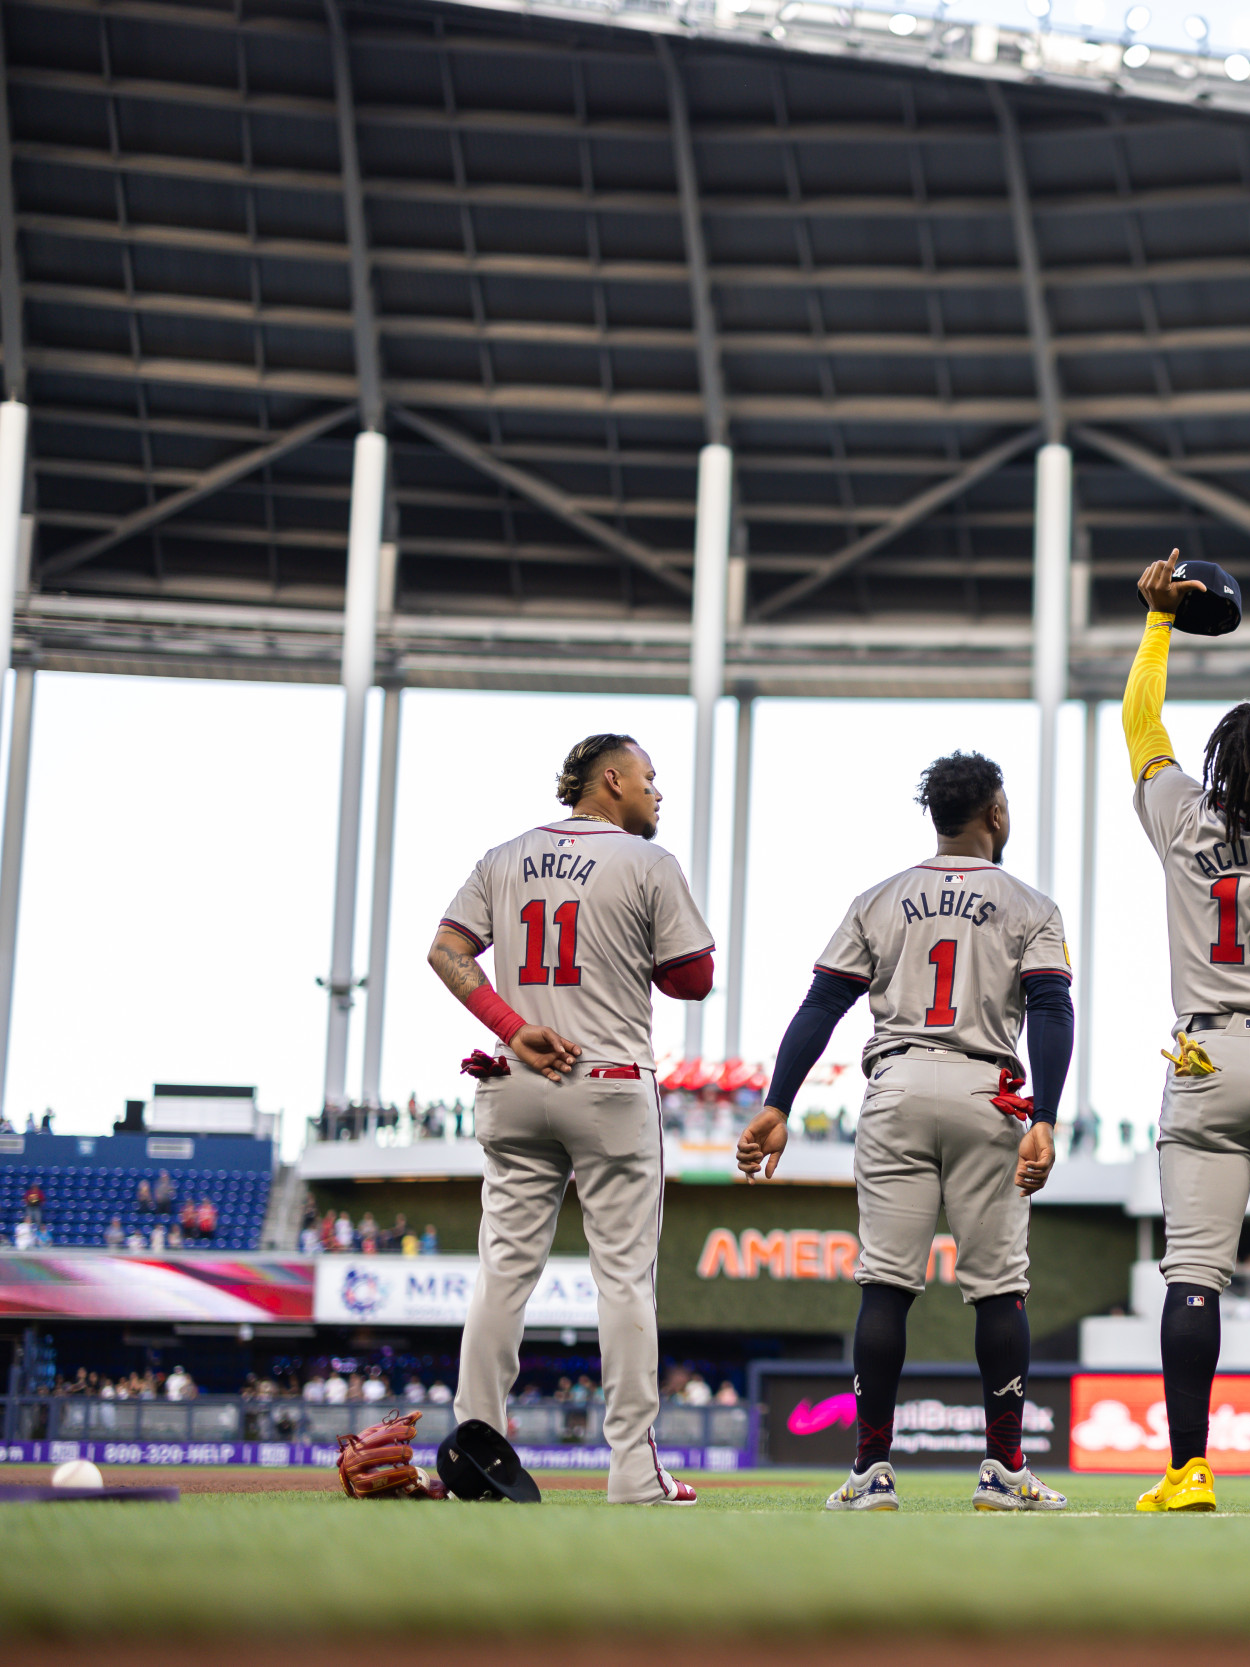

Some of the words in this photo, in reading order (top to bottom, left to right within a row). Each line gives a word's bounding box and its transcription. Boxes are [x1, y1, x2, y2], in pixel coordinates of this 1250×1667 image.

[523, 853, 596, 885] ARCIA
[902, 890, 996, 926] ALBIES
[518, 899, 581, 986] 11
[924, 939, 957, 1027] 1
[103, 1443, 235, 1465] 800-320-HELP
